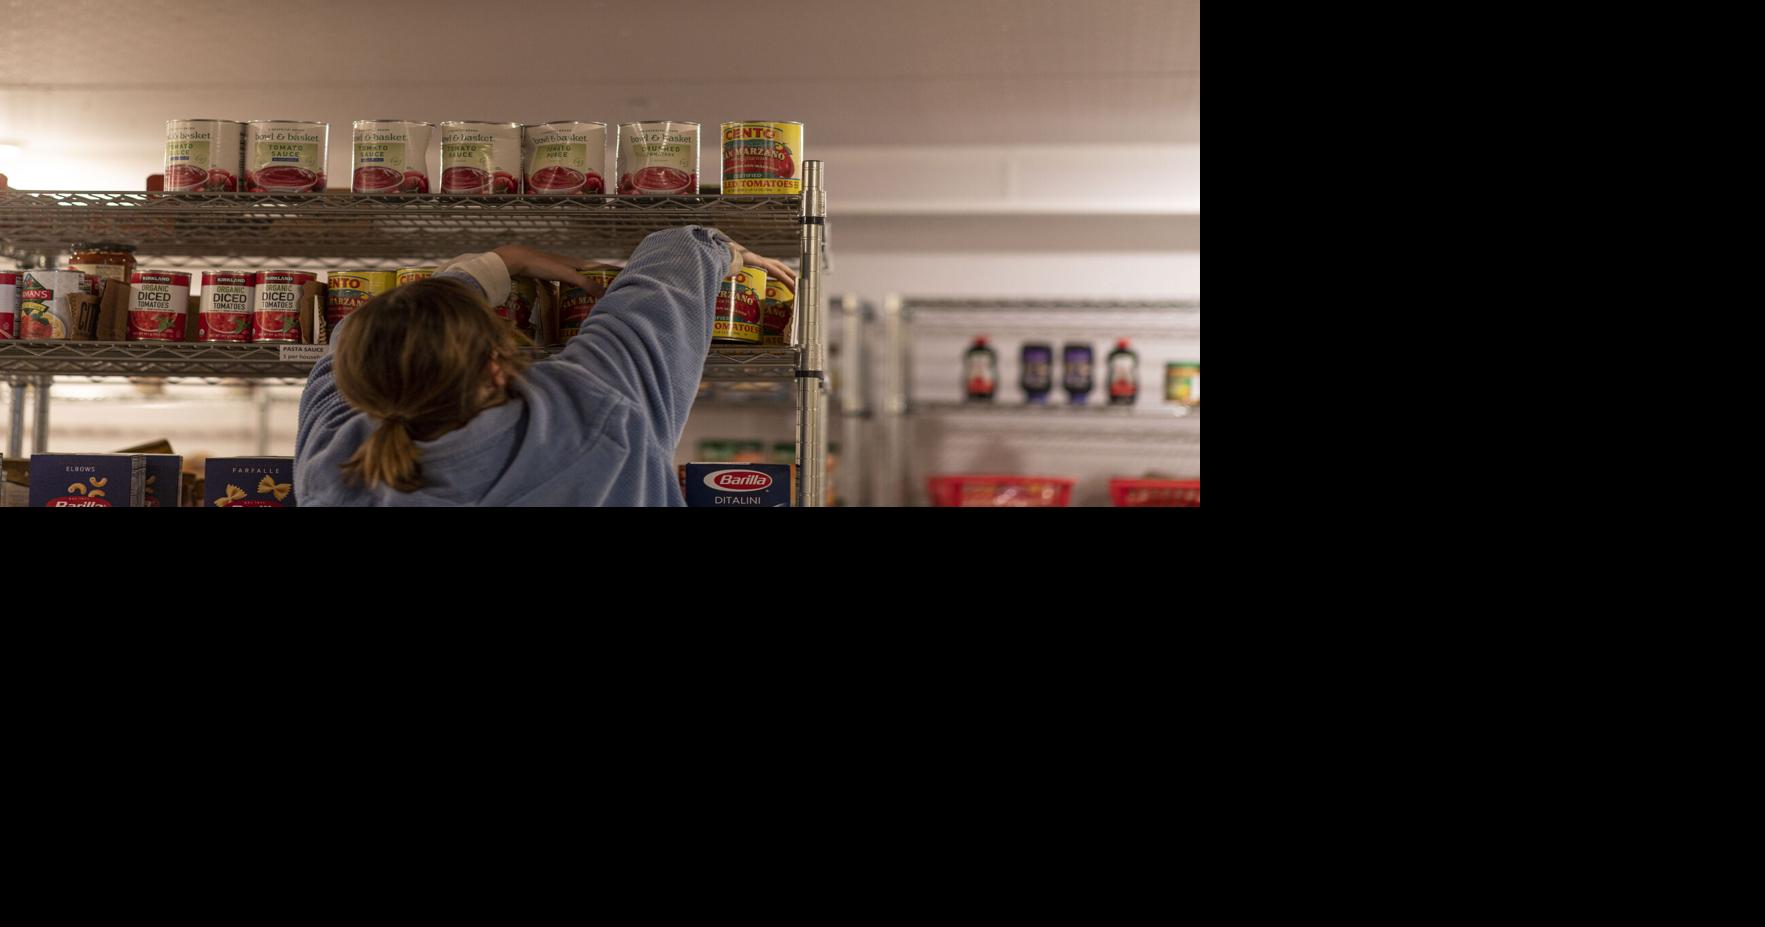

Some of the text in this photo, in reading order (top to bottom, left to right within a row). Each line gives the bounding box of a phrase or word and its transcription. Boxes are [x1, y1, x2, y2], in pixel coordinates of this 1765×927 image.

[276, 133, 286, 141] &
[725, 127, 776, 140] CENTO
[735, 147, 785, 161] MARZANO
[742, 180, 793, 188] TOMATOES
[265, 284, 293, 292] ORGANIC
[328, 278, 360, 289] ENTO
[138, 291, 172, 302] DICED
[213, 293, 247, 303] DICED
[261, 292, 295, 302] DICED
[719, 290, 754, 306] RZANO
[138, 301, 170, 309] TOMATOES
[213, 303, 246, 311] TOMATOES
[261, 301, 294, 309] TOMATOES
[714, 322, 759, 334] OMATOES
[720, 475, 766, 485] Barilla
[715, 496, 761, 504] DITALINI
